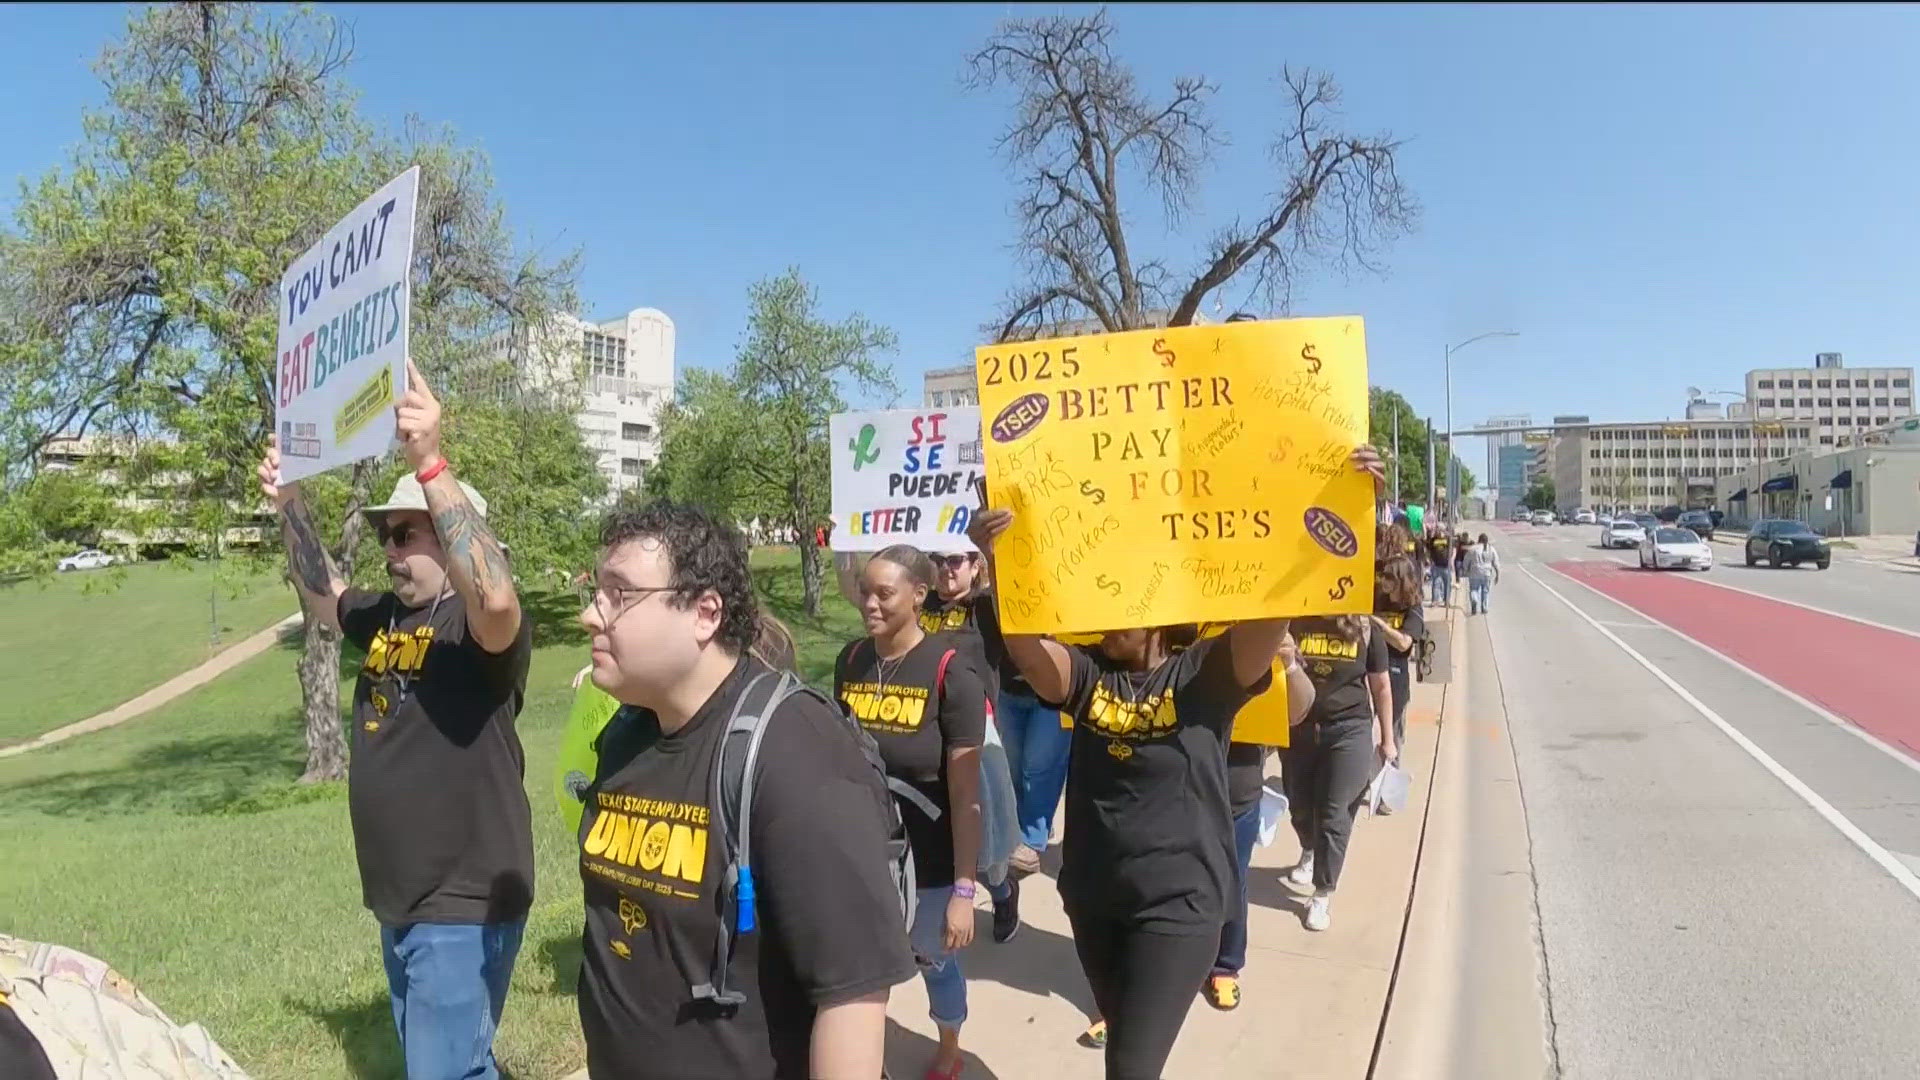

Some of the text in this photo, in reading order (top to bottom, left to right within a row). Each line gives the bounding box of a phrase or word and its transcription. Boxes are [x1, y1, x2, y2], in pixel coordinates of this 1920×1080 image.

[288, 198, 396, 325] YOU CAN'T
[281, 331, 315, 408] EAT
[313, 282, 401, 389] BENEFITS
[983, 347, 1080, 386] 2025
[1057, 376, 1234, 421] BETTER
[907, 413, 948, 445] SI
[996, 398, 1043, 438] TSEU
[903, 443, 944, 473] SE
[1092, 428, 1171, 461] PAY
[1129, 468, 1214, 501] FOR
[850, 505, 922, 536] BETTER
[1162, 509, 1270, 541] TSE'S
[1311, 510, 1353, 553] TSEU
[623, 795, 650, 813] STATE
[584, 810, 708, 883] UNION
